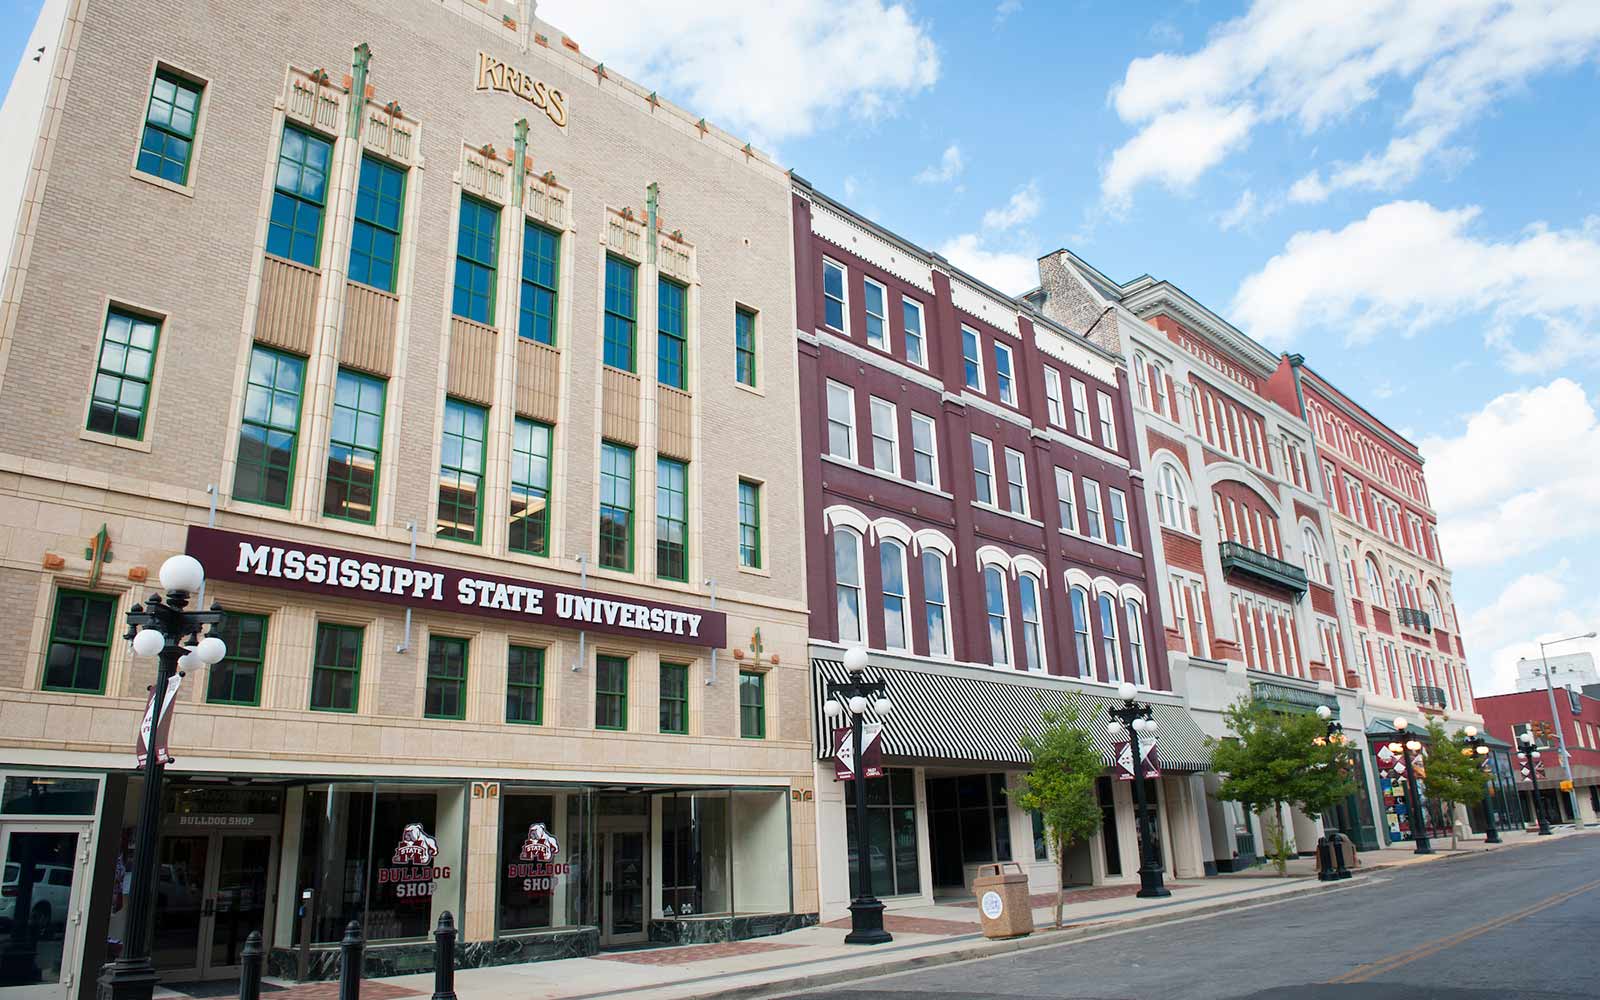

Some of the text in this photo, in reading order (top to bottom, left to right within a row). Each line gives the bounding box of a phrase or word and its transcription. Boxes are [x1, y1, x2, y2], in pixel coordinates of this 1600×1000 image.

[475, 51, 567, 127] KRESS
[235, 542, 702, 637] MISSISSIPPI STATE UNIVERSITY
[180, 816, 255, 825] BULLDOG SHOP
[400, 847, 422, 855] STATE
[378, 866, 451, 883] BULLDOG
[508, 863, 571, 878] BULLDOG
[396, 882, 438, 897] SHOP
[523, 877, 560, 891] SHOP
